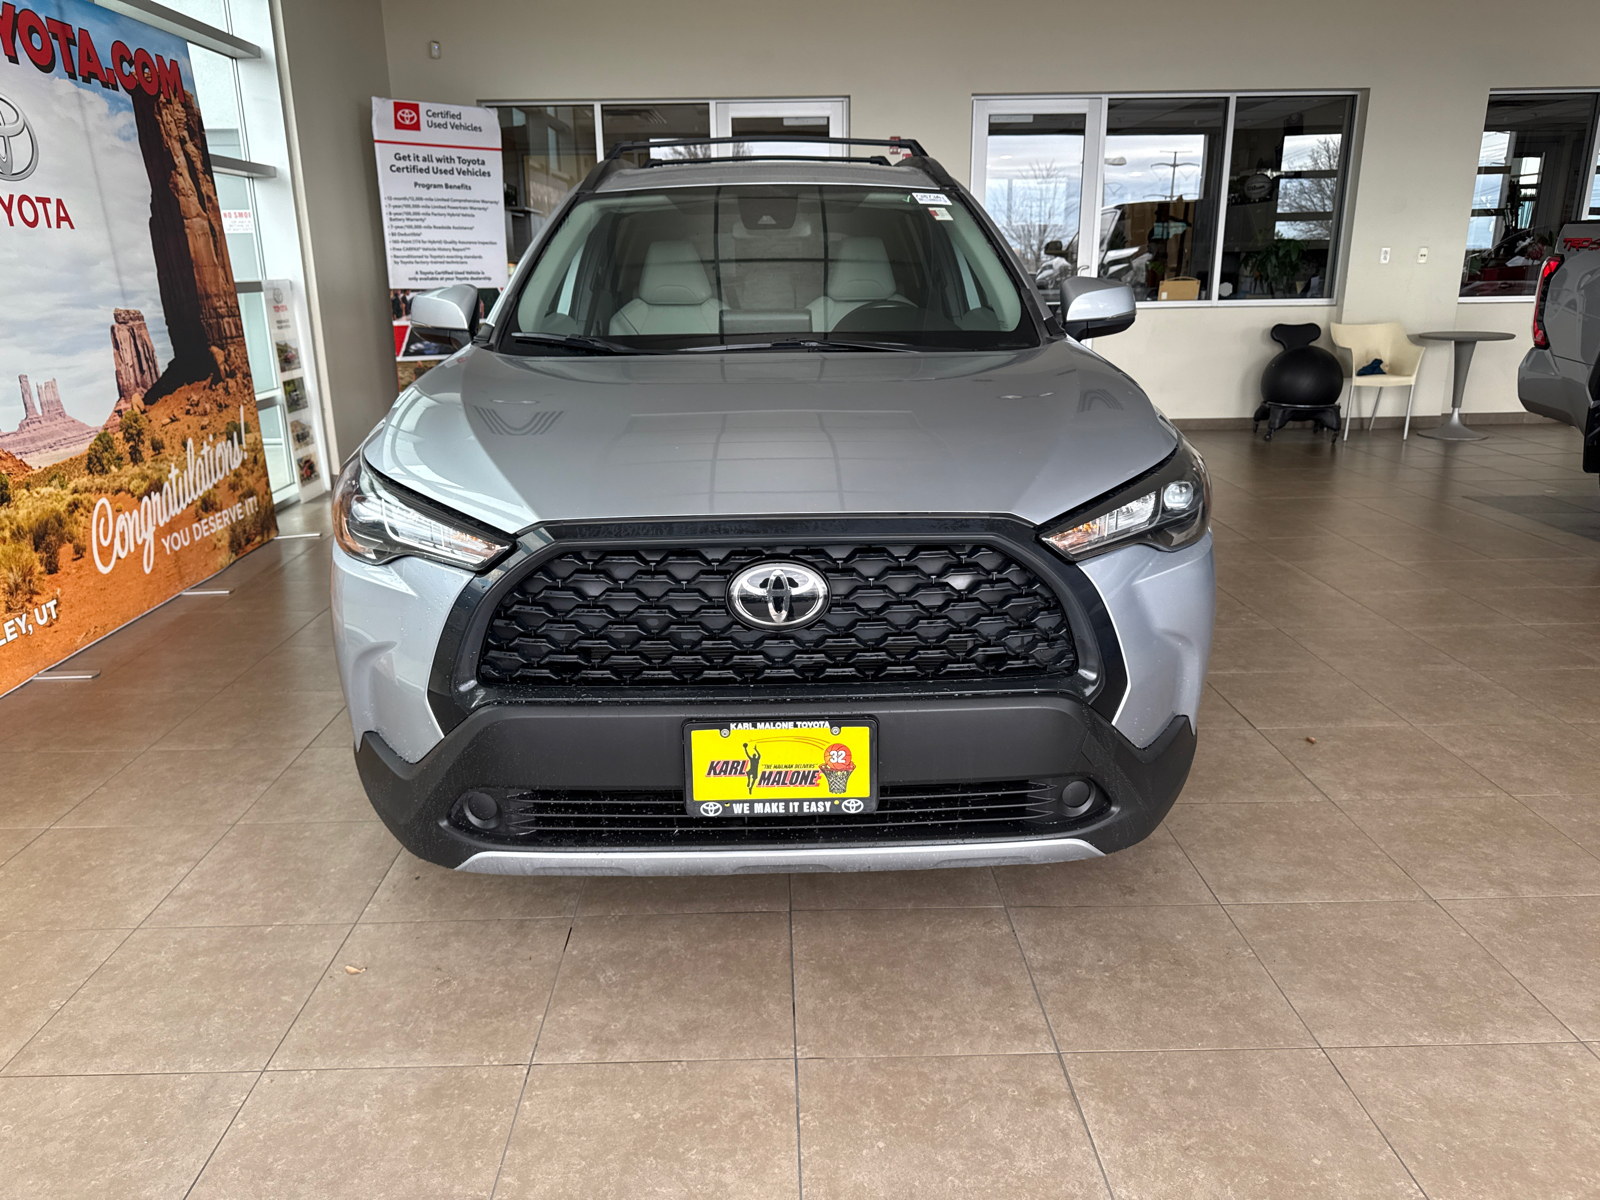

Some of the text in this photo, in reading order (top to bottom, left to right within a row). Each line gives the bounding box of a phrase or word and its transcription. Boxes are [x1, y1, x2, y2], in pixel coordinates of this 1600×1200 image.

[426, 109, 462, 120] Certified
[427, 120, 482, 132] Used Vehicles
[394, 152, 486, 166] Get it all with Toyota
[390, 164, 491, 178] Certified Used Vehicles
[414, 182, 472, 190] Program Benefits
[1563, 237, 1592, 252] TRD
[92, 404, 248, 574] Congratulations!
[161, 496, 258, 555] YOU DESERVE IT!
[34, 599, 58, 626] UT
[757, 722, 794, 730] MALONE
[830, 750, 846, 764] 32
[705, 760, 749, 777] KARL
[756, 770, 822, 788] MALONE
[733, 801, 831, 814] WE MAKE IT EASY
